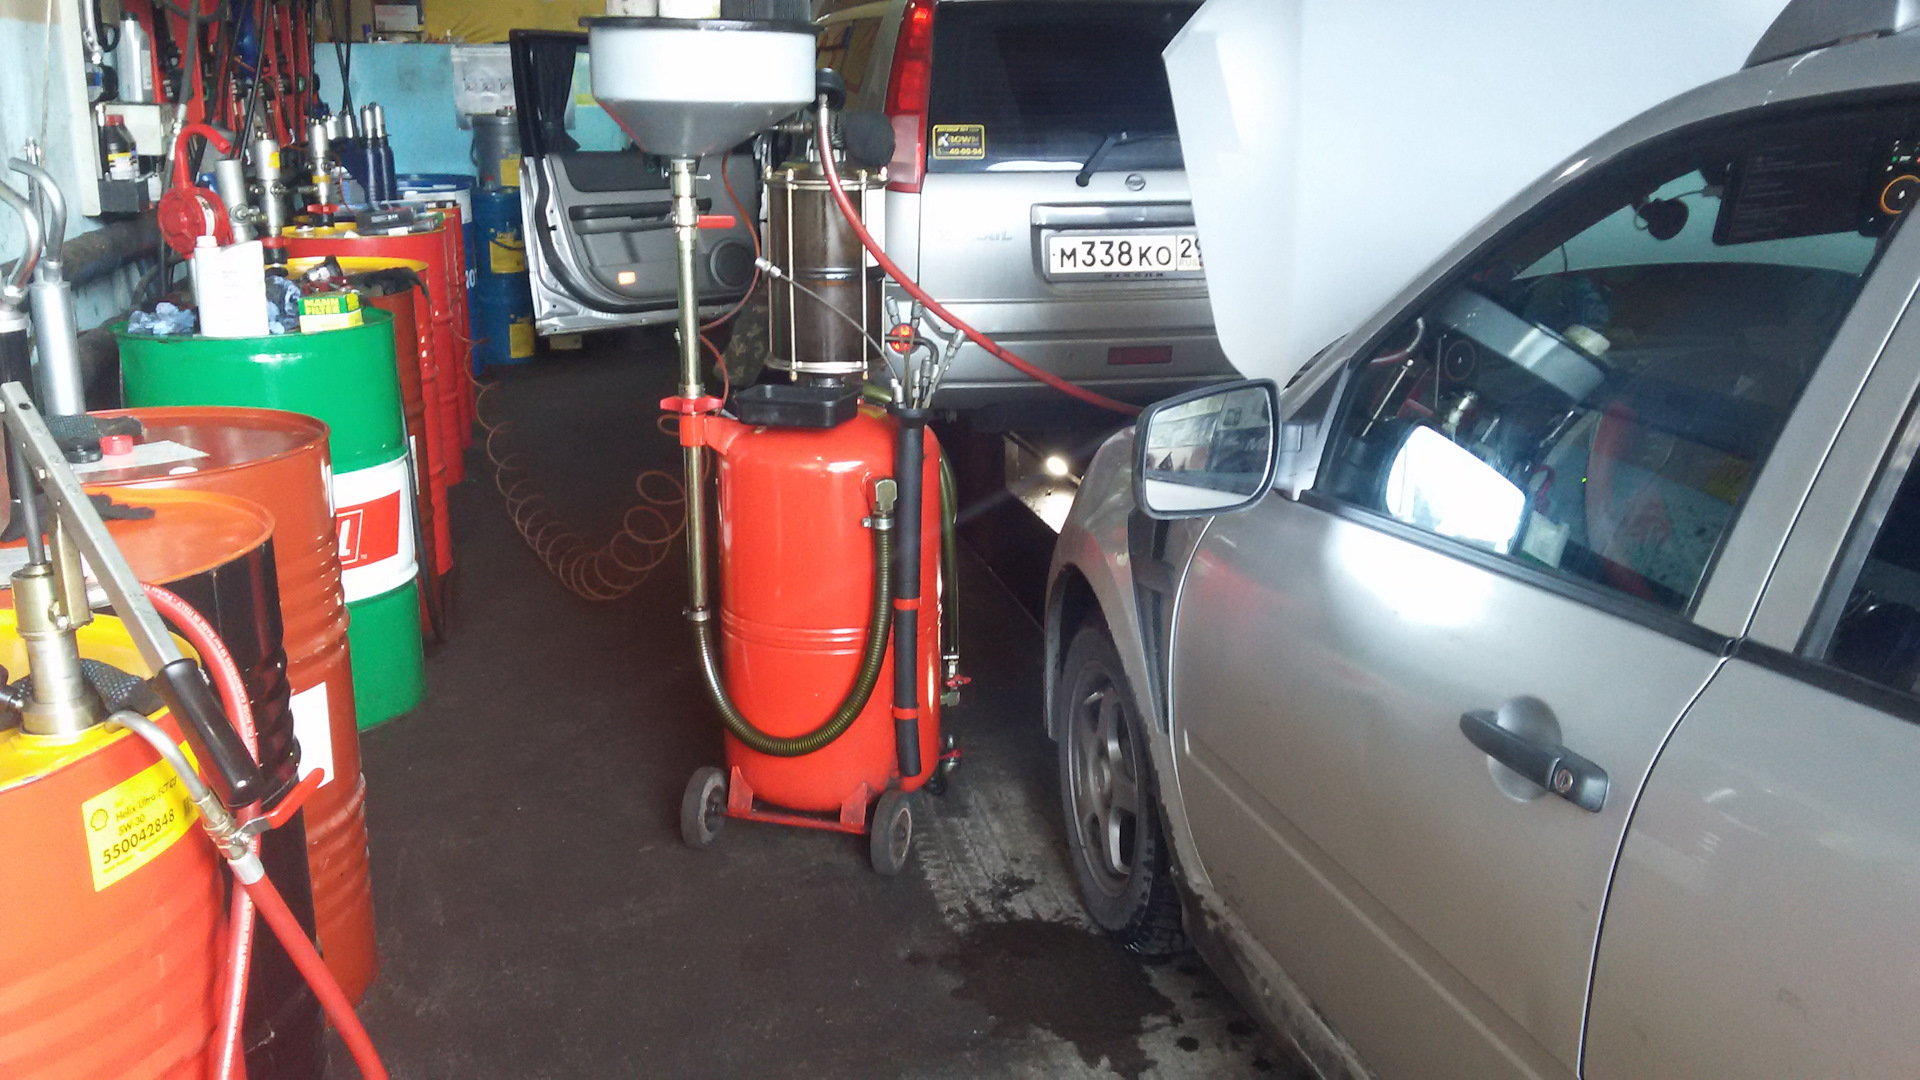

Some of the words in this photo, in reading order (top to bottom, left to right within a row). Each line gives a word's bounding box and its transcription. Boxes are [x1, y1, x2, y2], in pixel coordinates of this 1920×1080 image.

[303, 297, 340, 306] MANN
[305, 306, 340, 315] FILTER
[175, 599, 195, 617] ITALY
[103, 808, 175, 864] 550042848
